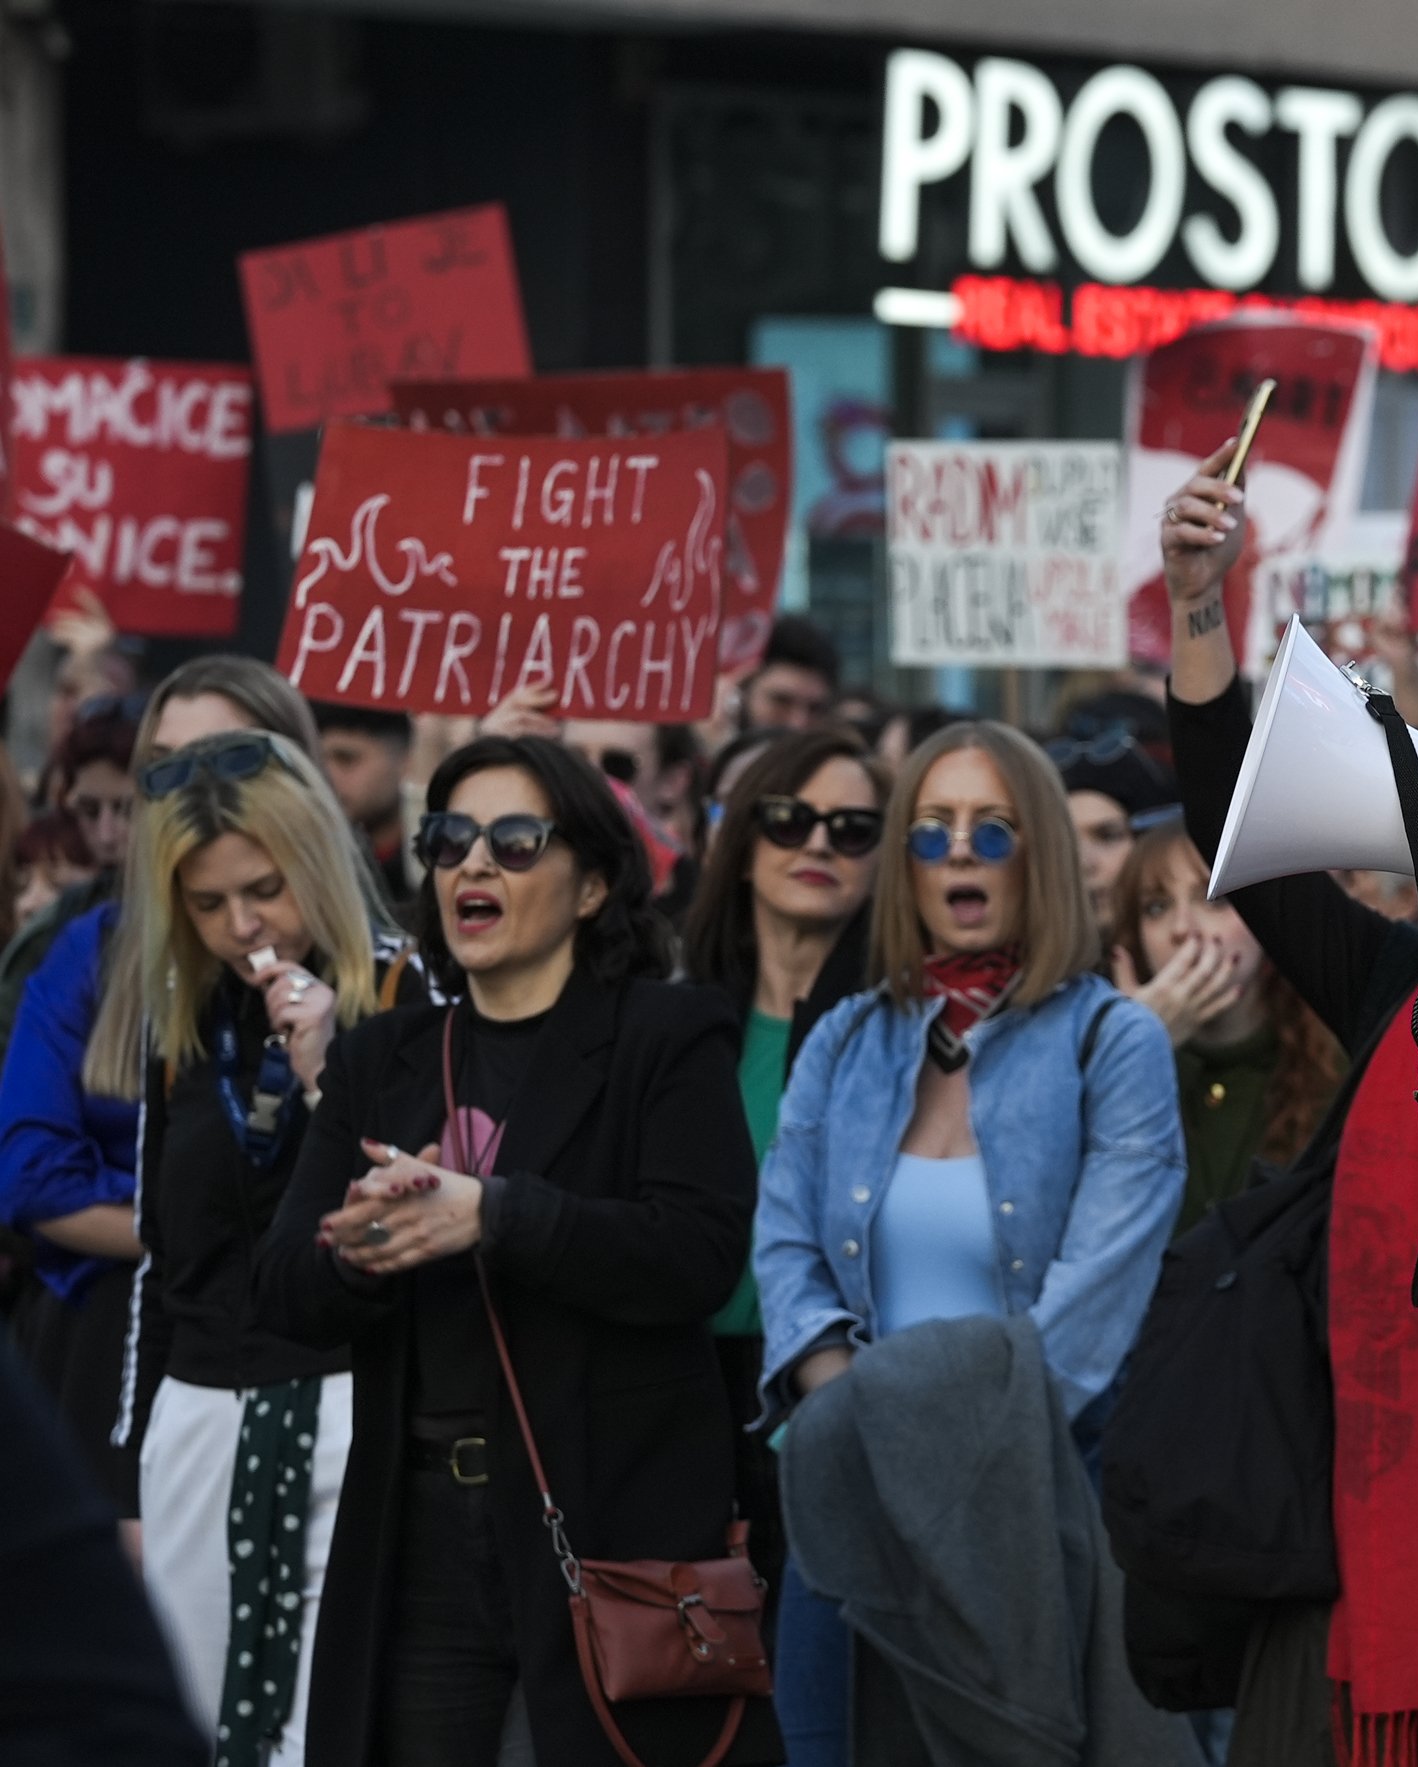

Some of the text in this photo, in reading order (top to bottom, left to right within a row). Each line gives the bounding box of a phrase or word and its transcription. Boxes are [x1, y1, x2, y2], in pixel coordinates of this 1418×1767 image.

[462, 453, 660, 530] FIGHT
[499, 546, 588, 600] THE
[288, 602, 711, 712] PATRIARCHY
